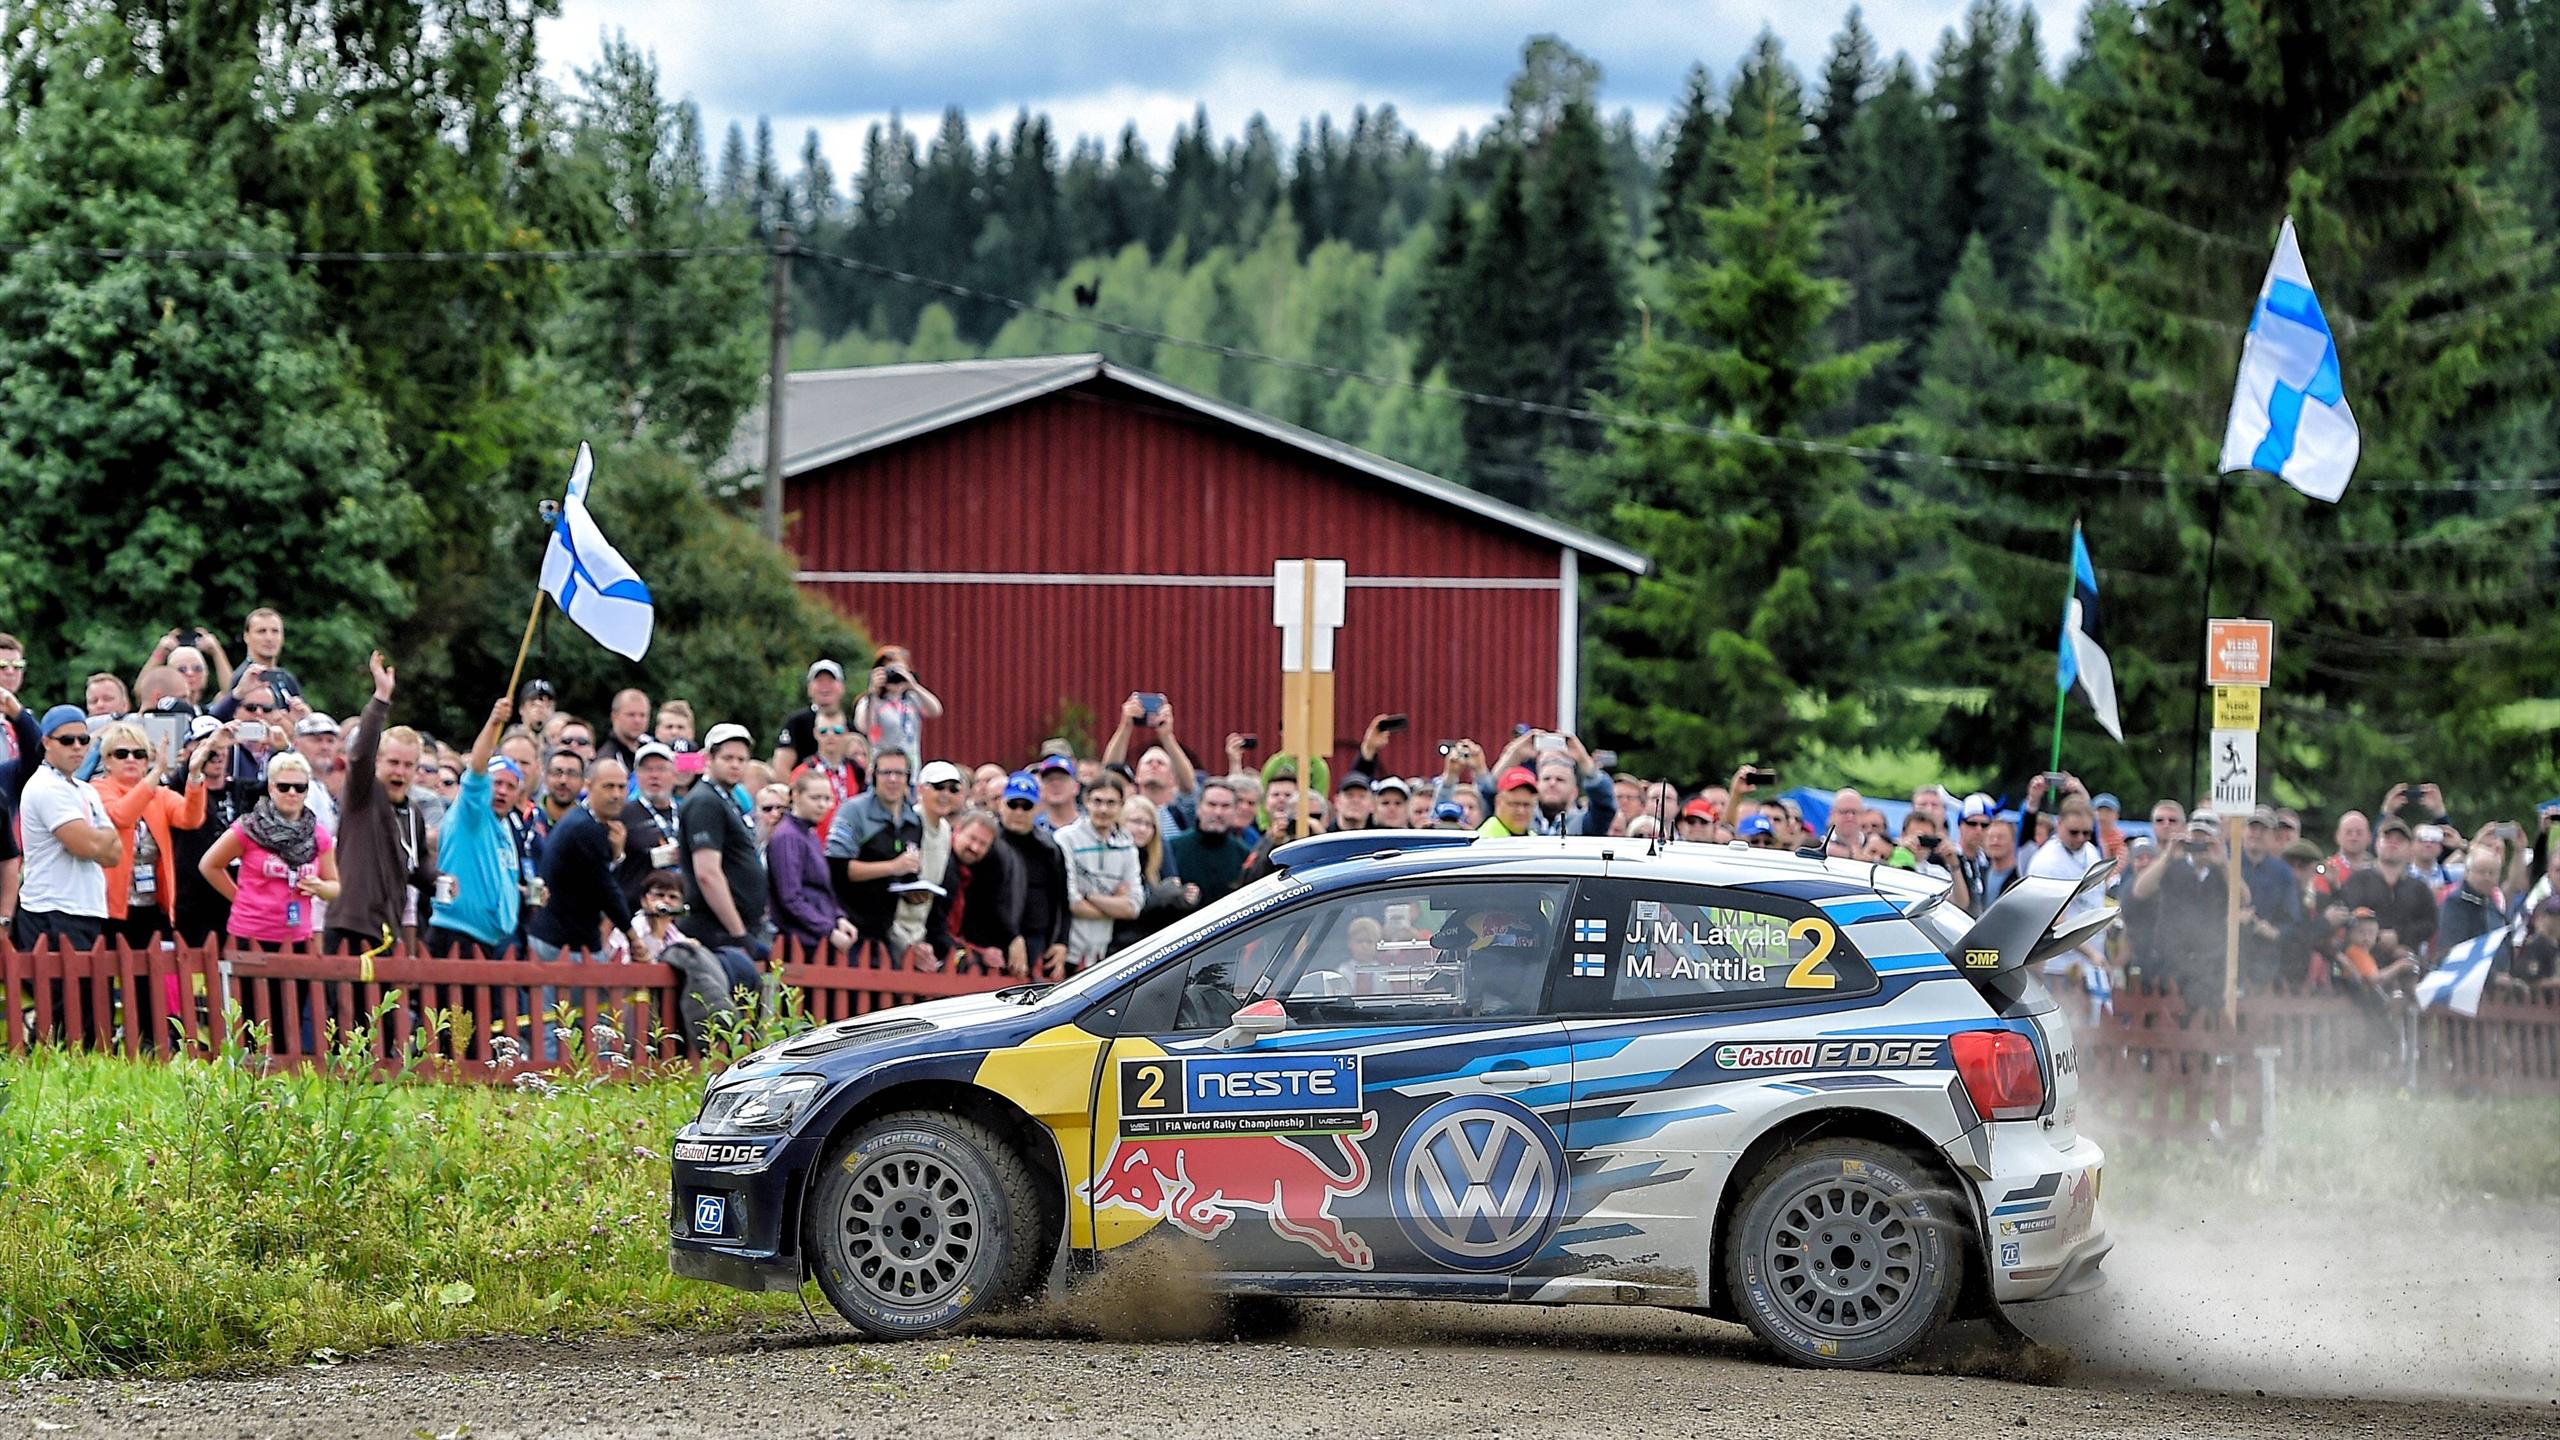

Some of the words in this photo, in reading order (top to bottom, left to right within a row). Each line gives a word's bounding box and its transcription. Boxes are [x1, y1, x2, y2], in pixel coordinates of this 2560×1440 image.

[1115, 883, 1313, 981] www.volkswagen-motorsport.com
[1626, 921, 1647, 943] J.
[1653, 921, 1684, 943] M.
[1692, 922, 1787, 946] Latvala
[1785, 917, 1836, 989] 2
[1965, 952, 1999, 966] OMP
[1626, 955, 1662, 979] M.
[1671, 955, 1767, 982] Anttila
[1738, 1045, 1812, 1067] Castrol
[1816, 1042, 1942, 1068] EDGE
[1136, 1065, 1166, 1109] 2
[1165, 1121, 1181, 1131] FIA
[1183, 1120, 1211, 1130] World
[1213, 1119, 1237, 1130] Rally
[1239, 1117, 1305, 1130] Championship
[679, 1144, 706, 1159] Castrol
[706, 1145, 768, 1162] EDGE
[866, 1133, 933, 1152] MICHELIN
[2020, 1218, 2055, 1230] MICHELIN
[881, 1306, 949, 1325] MICHELIN
[1752, 1290, 1809, 1346] MICHELIN
